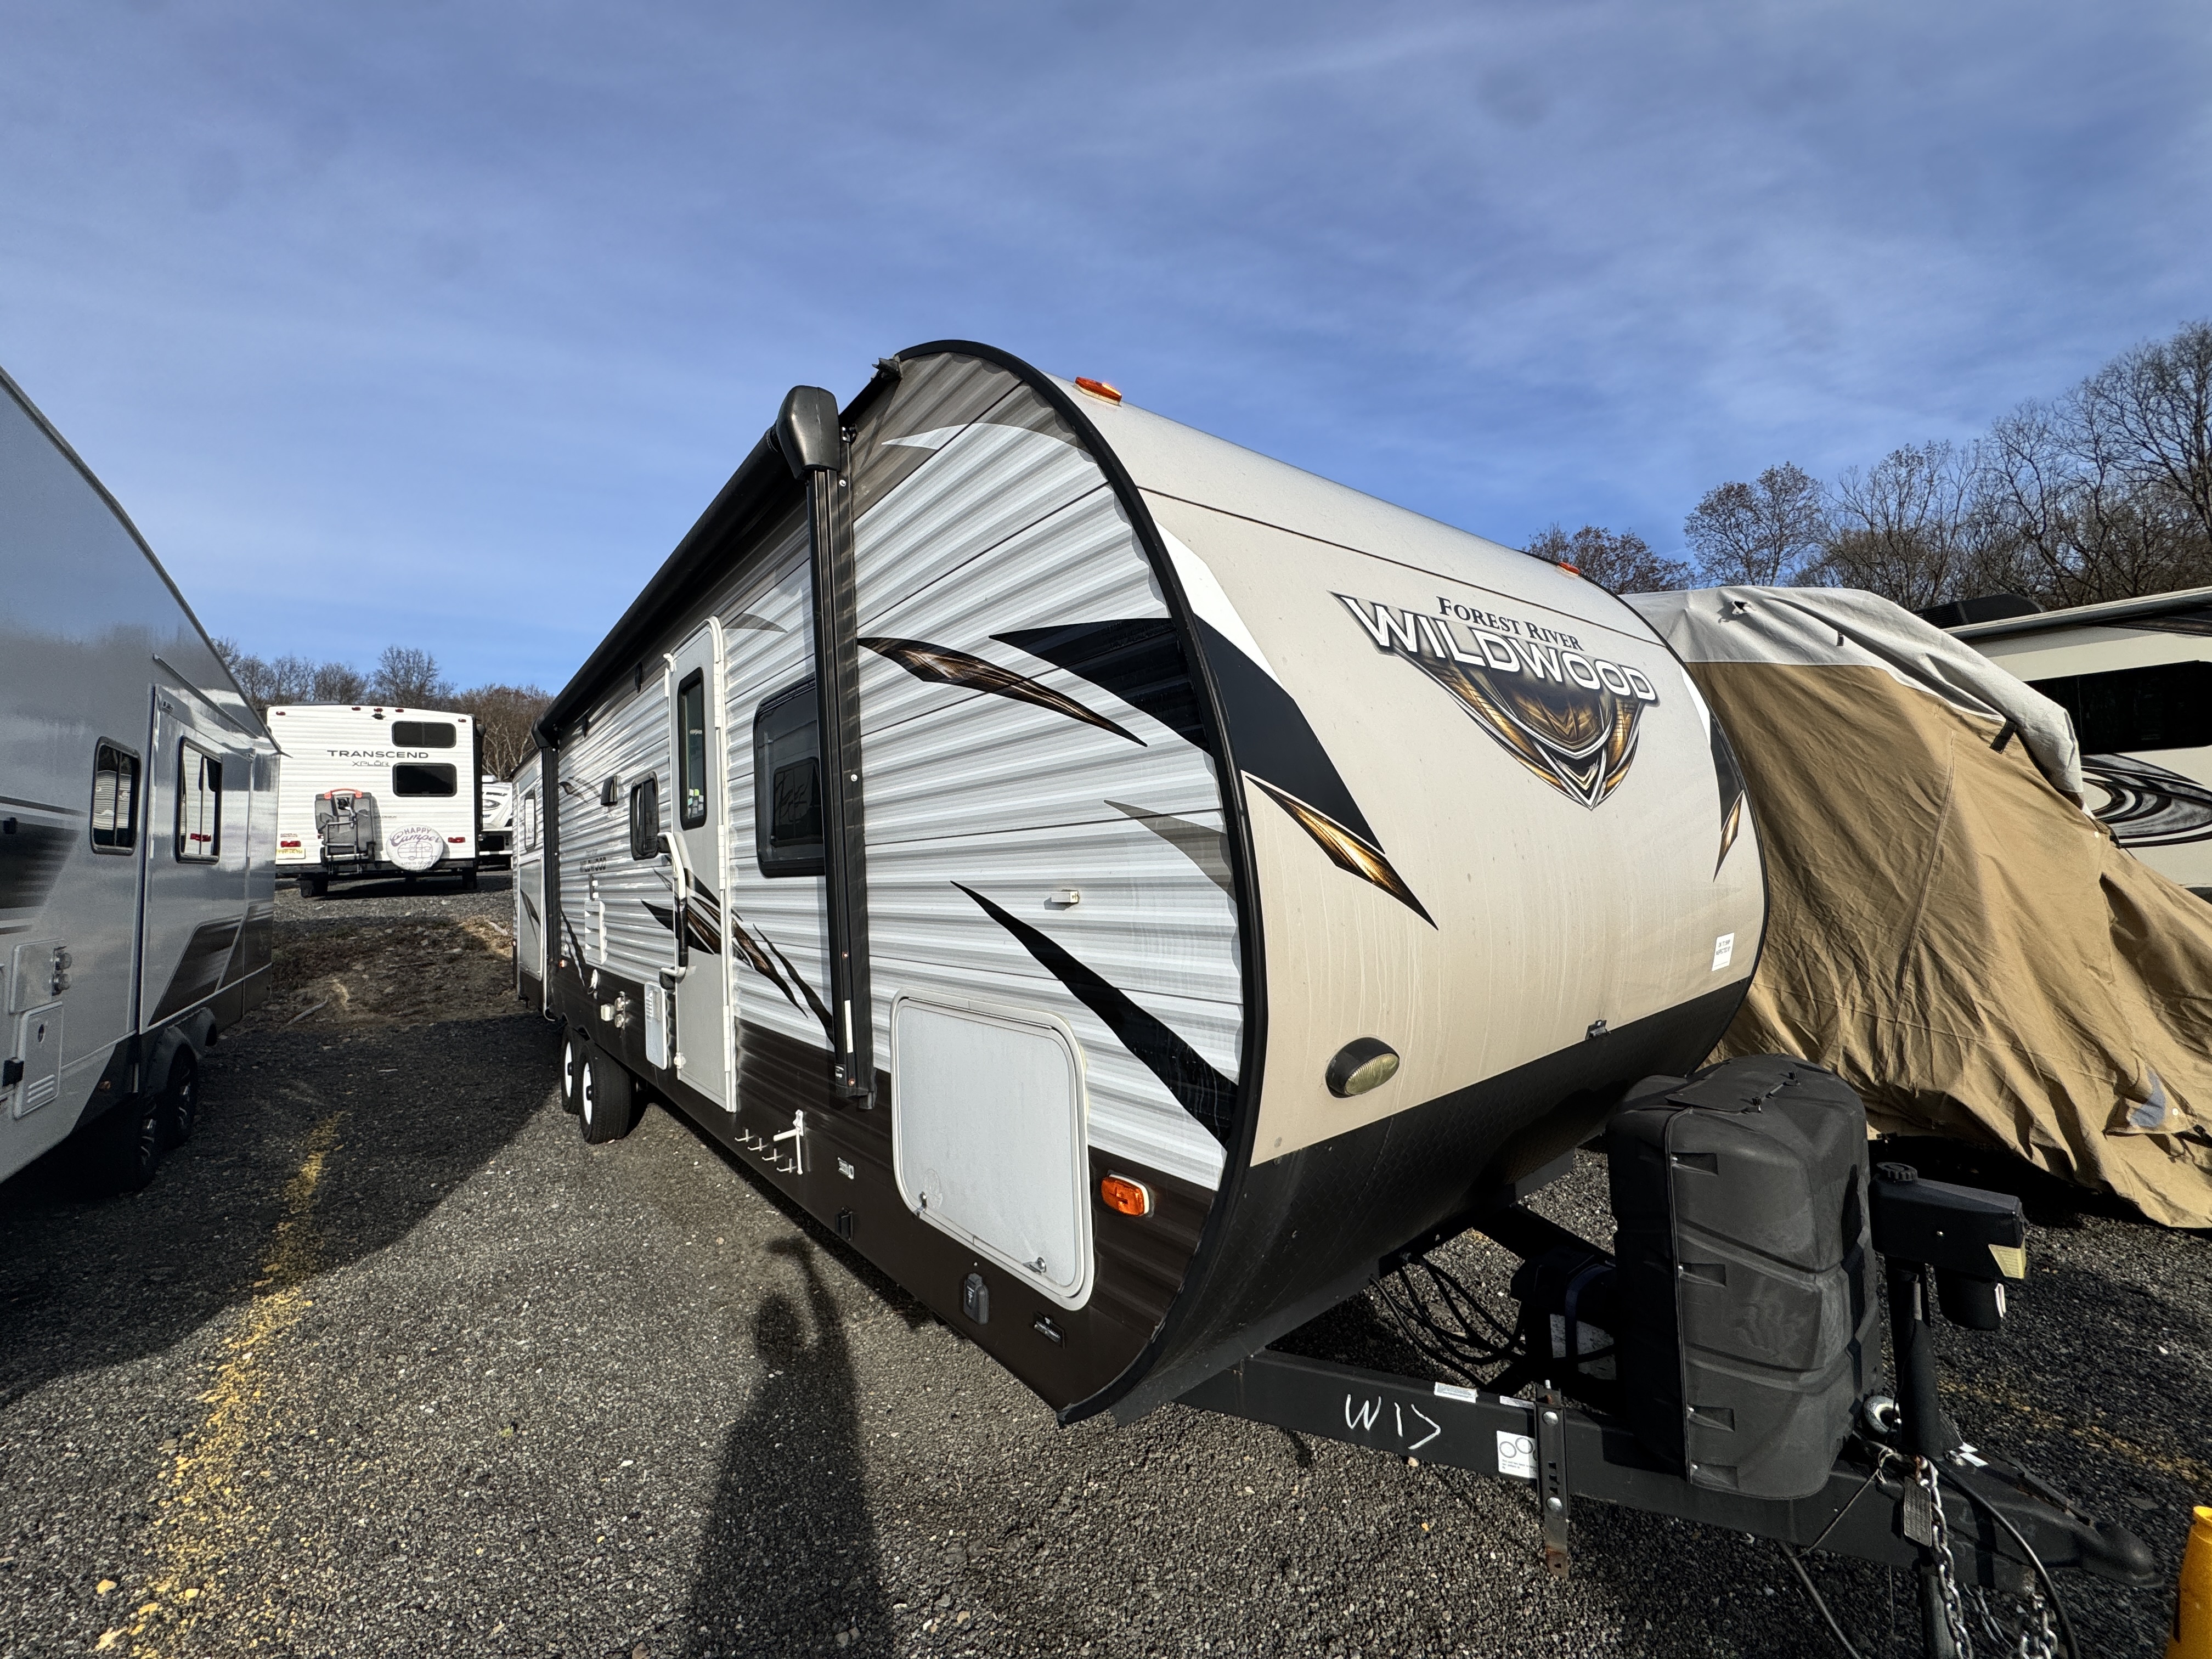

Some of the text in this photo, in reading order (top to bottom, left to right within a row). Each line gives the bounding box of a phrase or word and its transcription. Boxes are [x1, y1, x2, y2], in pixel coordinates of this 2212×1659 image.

[1436, 595, 1585, 652] FOREST RIVER
[1339, 595, 1657, 701] WILDWOOD
[326, 749, 429, 759] TRANSCEND
[404, 827, 431, 835] HAPPY
